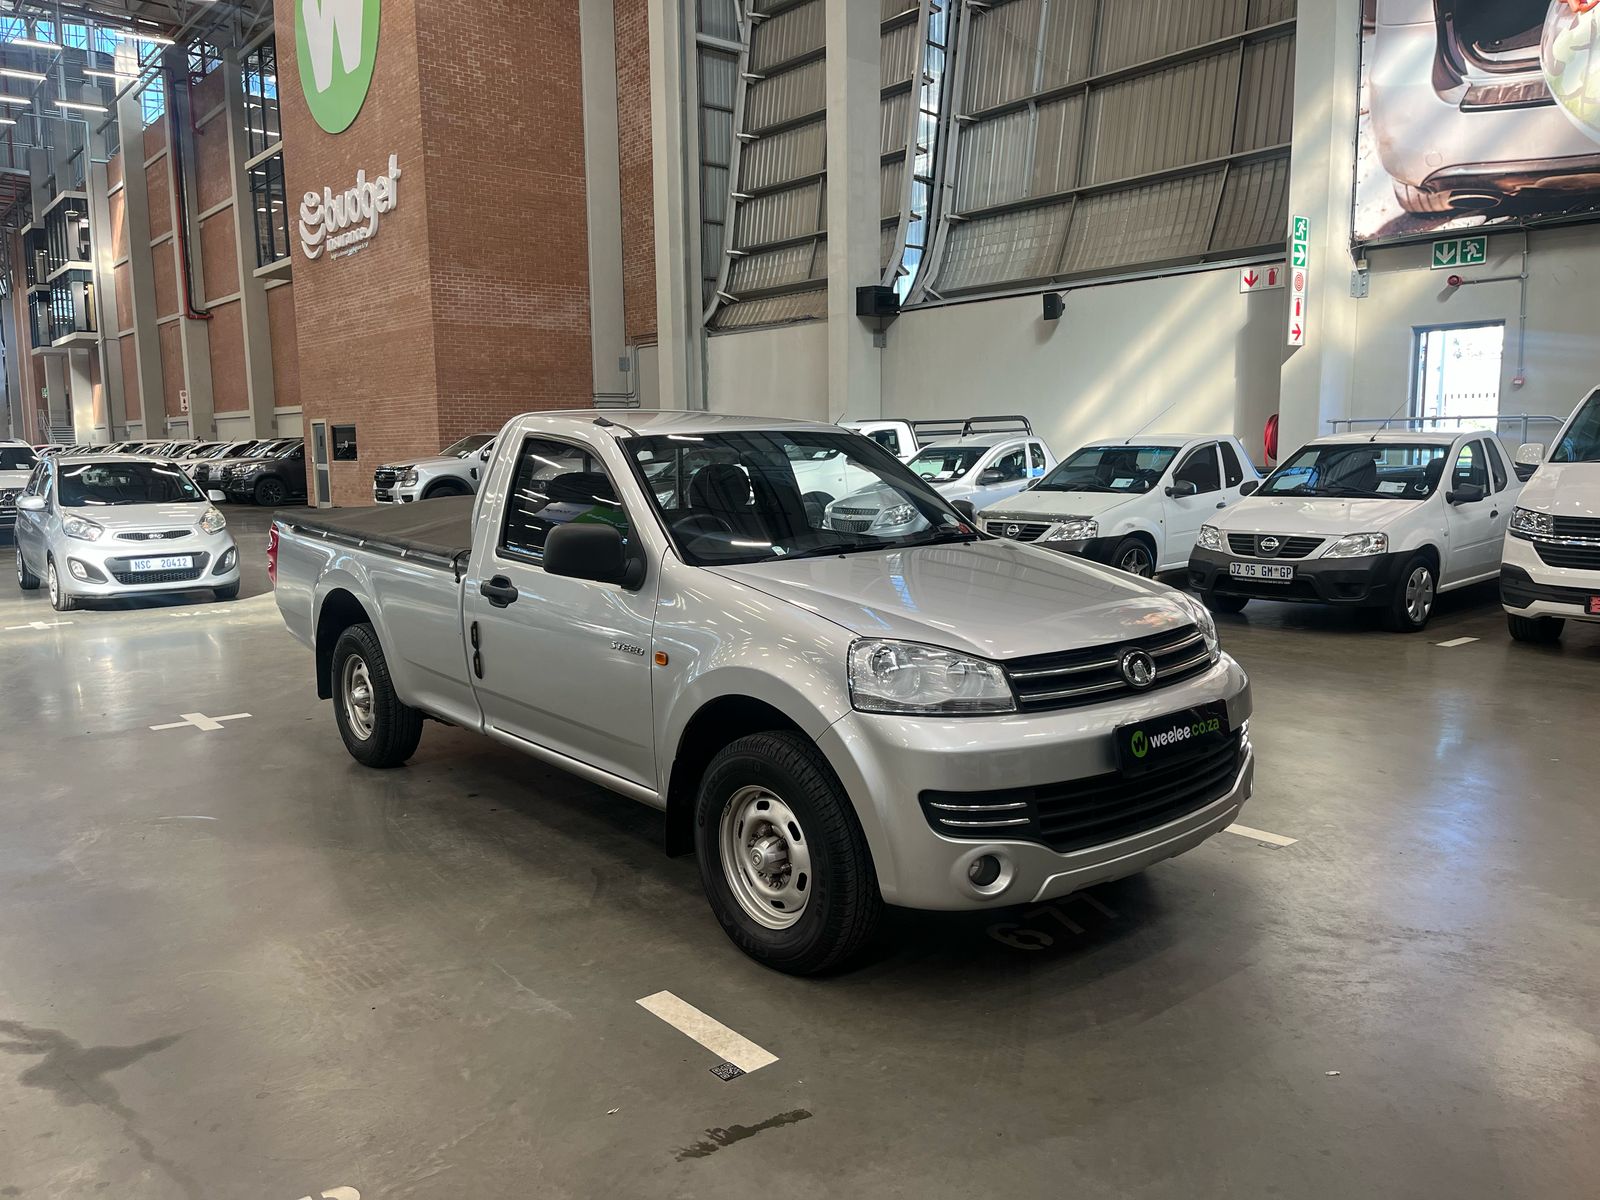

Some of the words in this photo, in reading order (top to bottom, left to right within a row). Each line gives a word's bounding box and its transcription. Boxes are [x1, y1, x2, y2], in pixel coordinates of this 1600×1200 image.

[324, 154, 402, 239] budget
[134, 559, 152, 570] NSC
[161, 557, 187, 568] 20412
[1231, 563, 1241, 575] JZ
[1245, 564, 1256, 576] 95
[1280, 566, 1292, 578] GP
[1150, 717, 1220, 749] weelee.co.za
